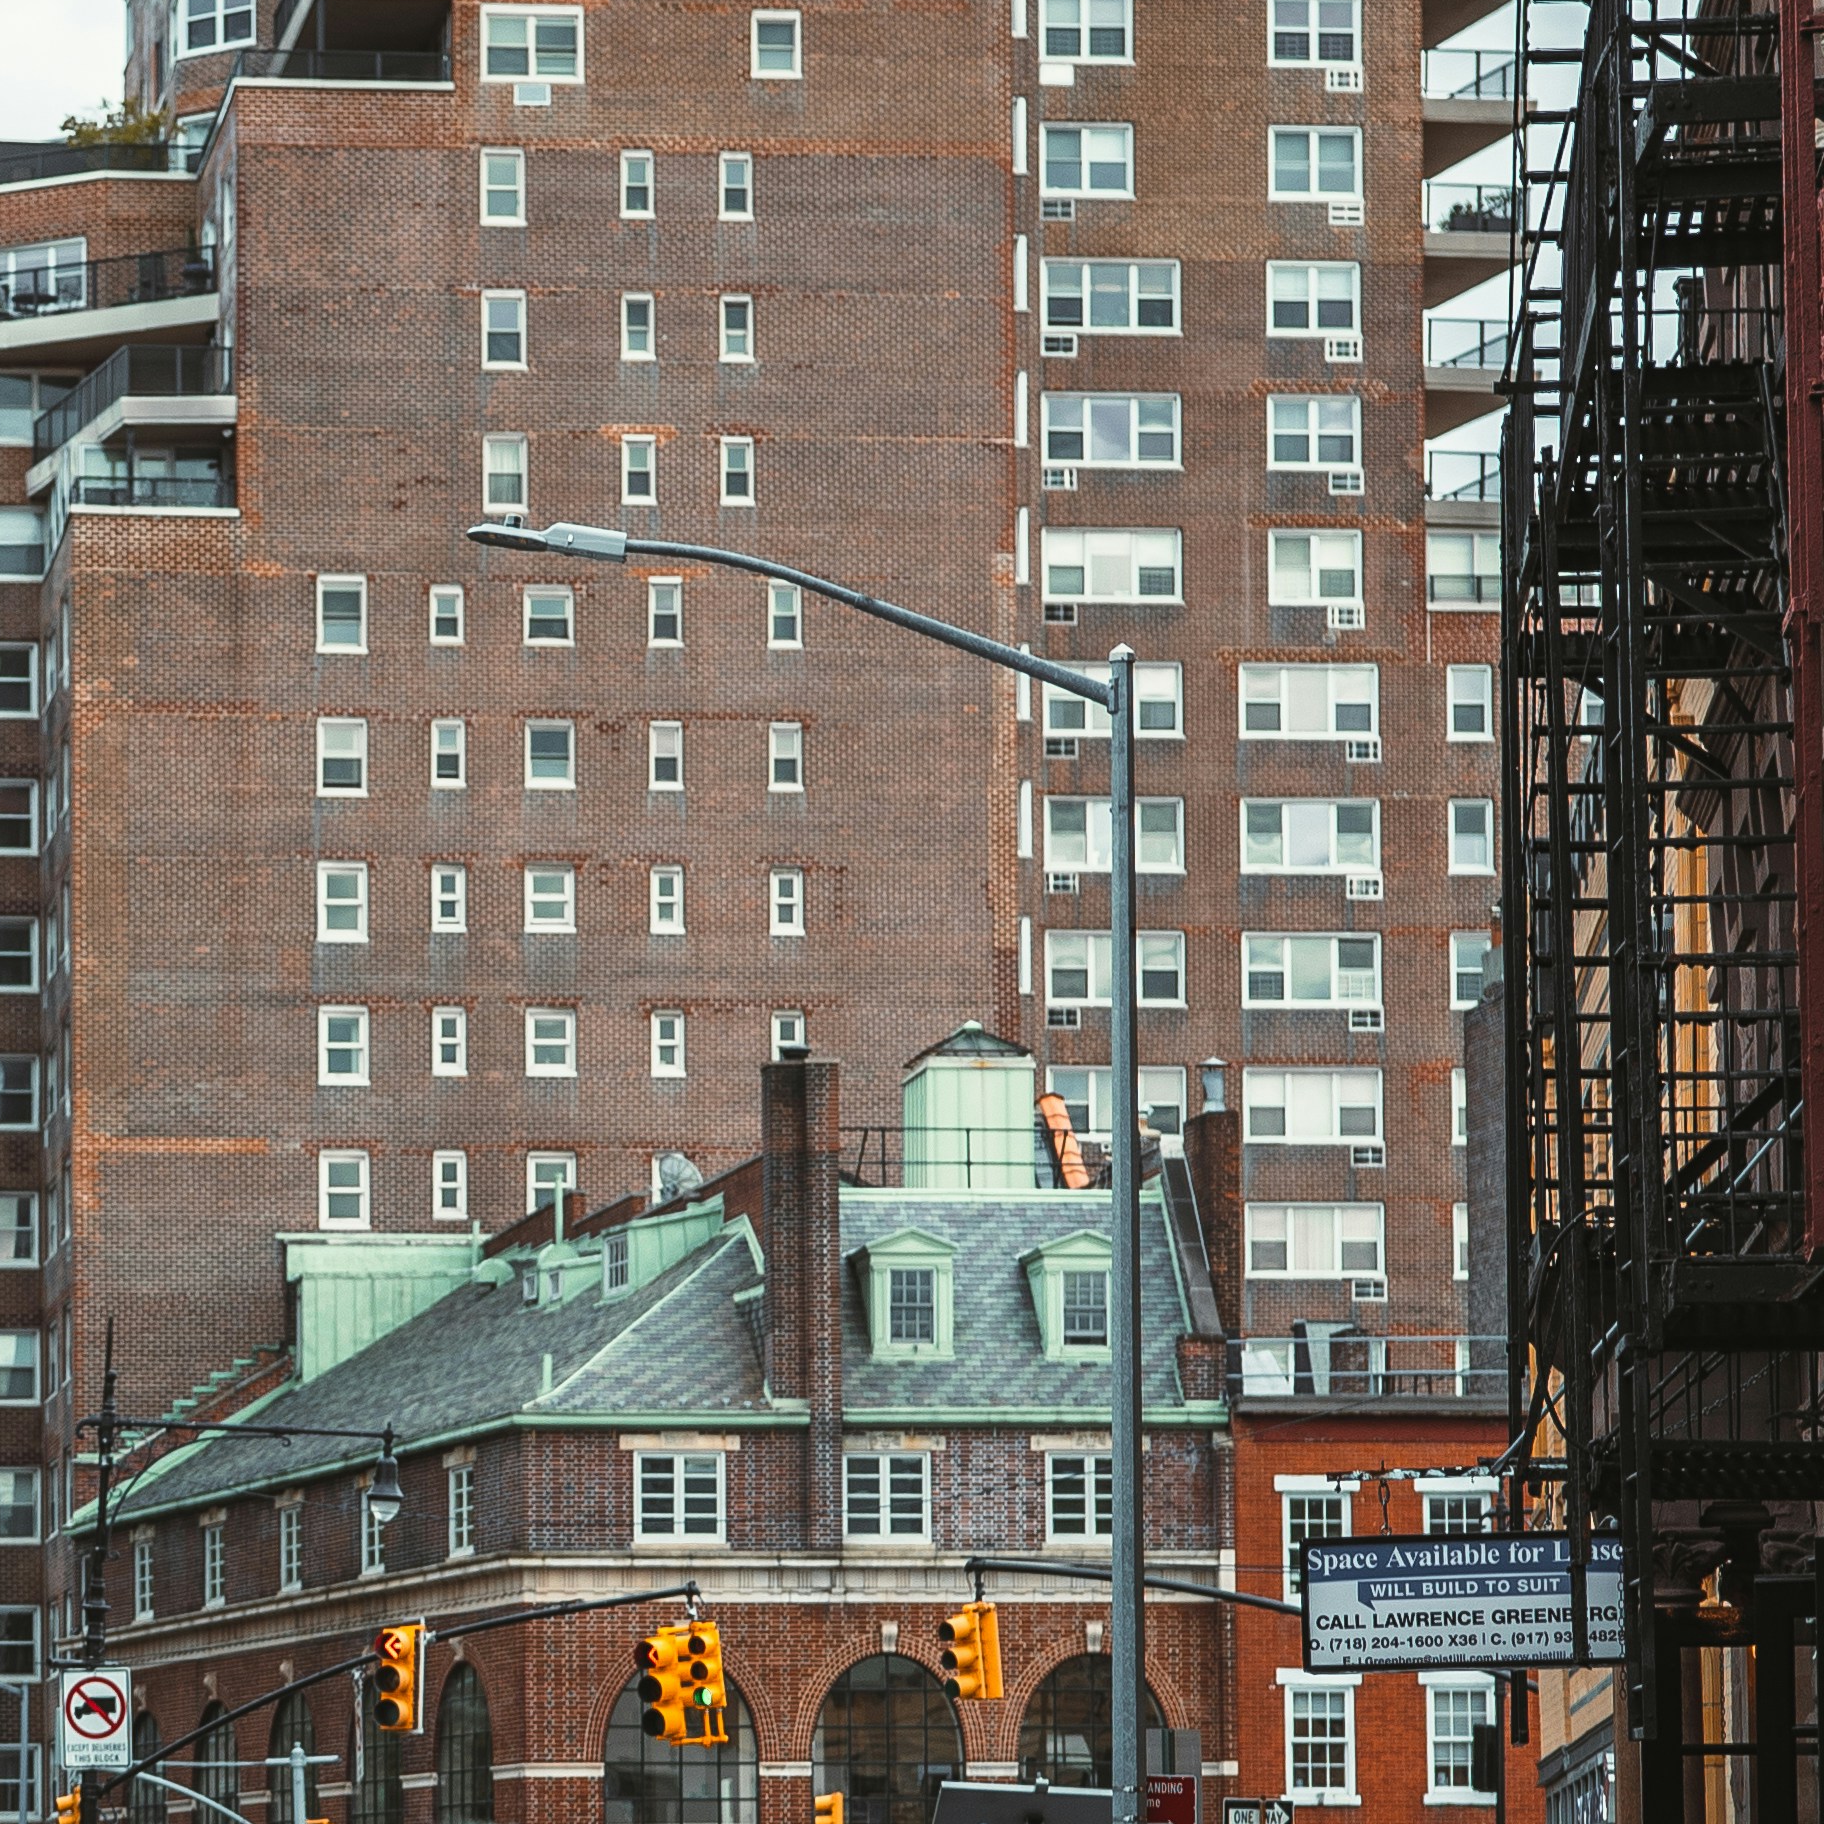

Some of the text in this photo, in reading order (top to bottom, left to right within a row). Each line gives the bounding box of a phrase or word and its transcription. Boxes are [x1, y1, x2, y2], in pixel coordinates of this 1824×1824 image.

[1307, 1547, 1378, 1576] Space
[1386, 1542, 1500, 1570] Available
[1508, 1541, 1544, 1565] for
[1370, 1577, 1561, 1598] WILL BUILD TO SUIT
[1316, 1606, 1618, 1631] CALL LAWRENCE GREENBRG
[1329, 1637, 1367, 1653] (718)
[1371, 1635, 1443, 1649] 204-1600
[1448, 1633, 1478, 1647] X36
[1490, 1632, 1507, 1646] C.
[1511, 1631, 1550, 1648] (917)
[1233, 1809, 1254, 1824] ONE
